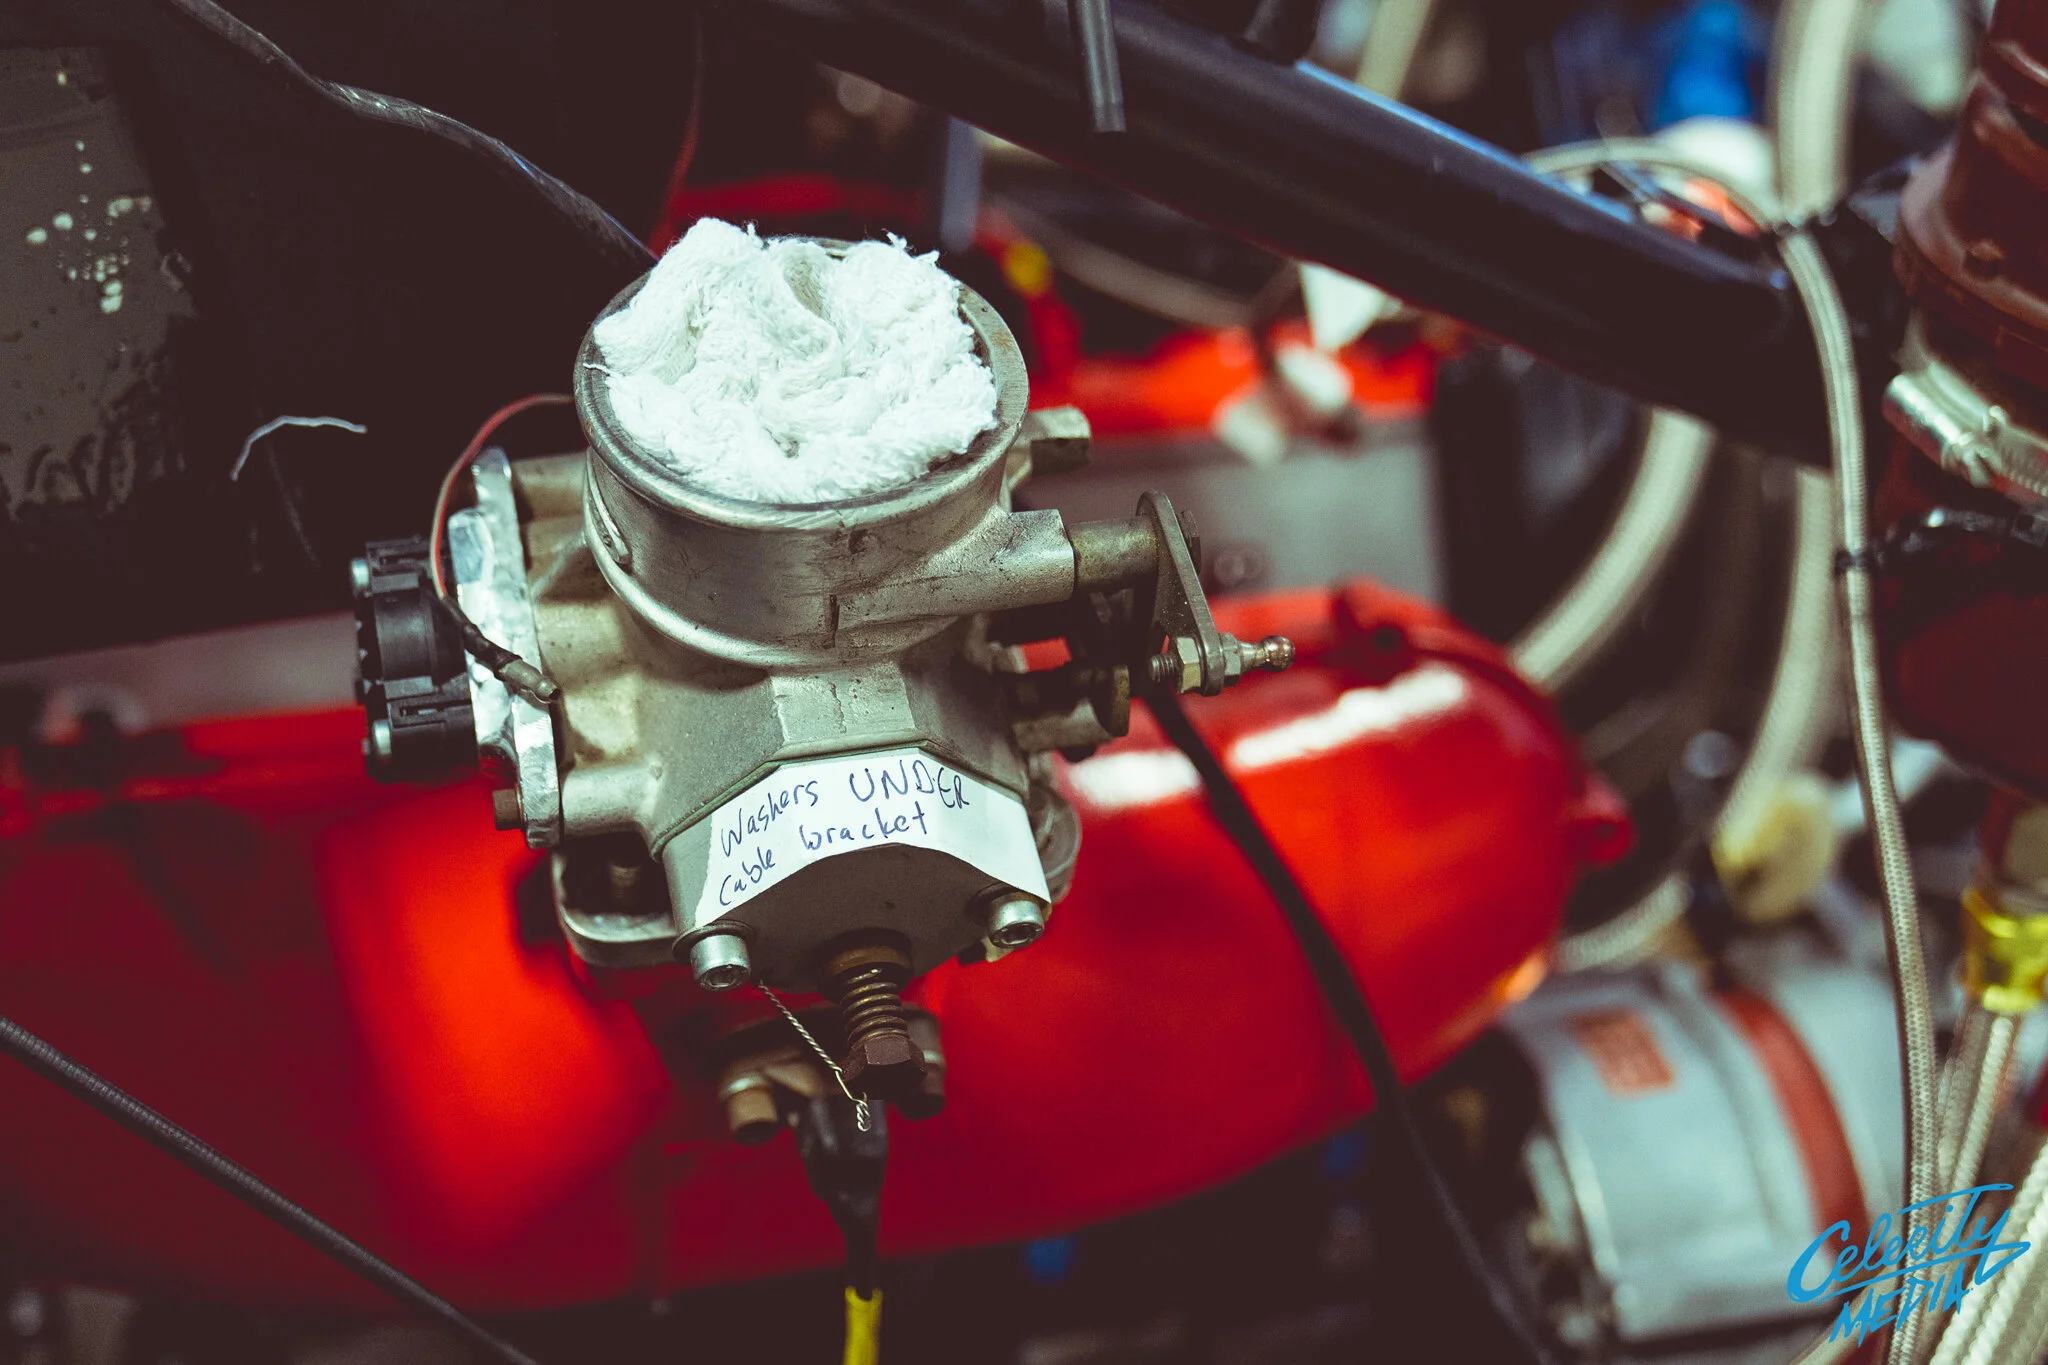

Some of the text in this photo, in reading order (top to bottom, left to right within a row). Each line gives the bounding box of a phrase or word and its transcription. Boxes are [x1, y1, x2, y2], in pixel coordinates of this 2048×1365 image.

[721, 759, 970, 857] Washers UNDER
[799, 802, 928, 850] bracket
